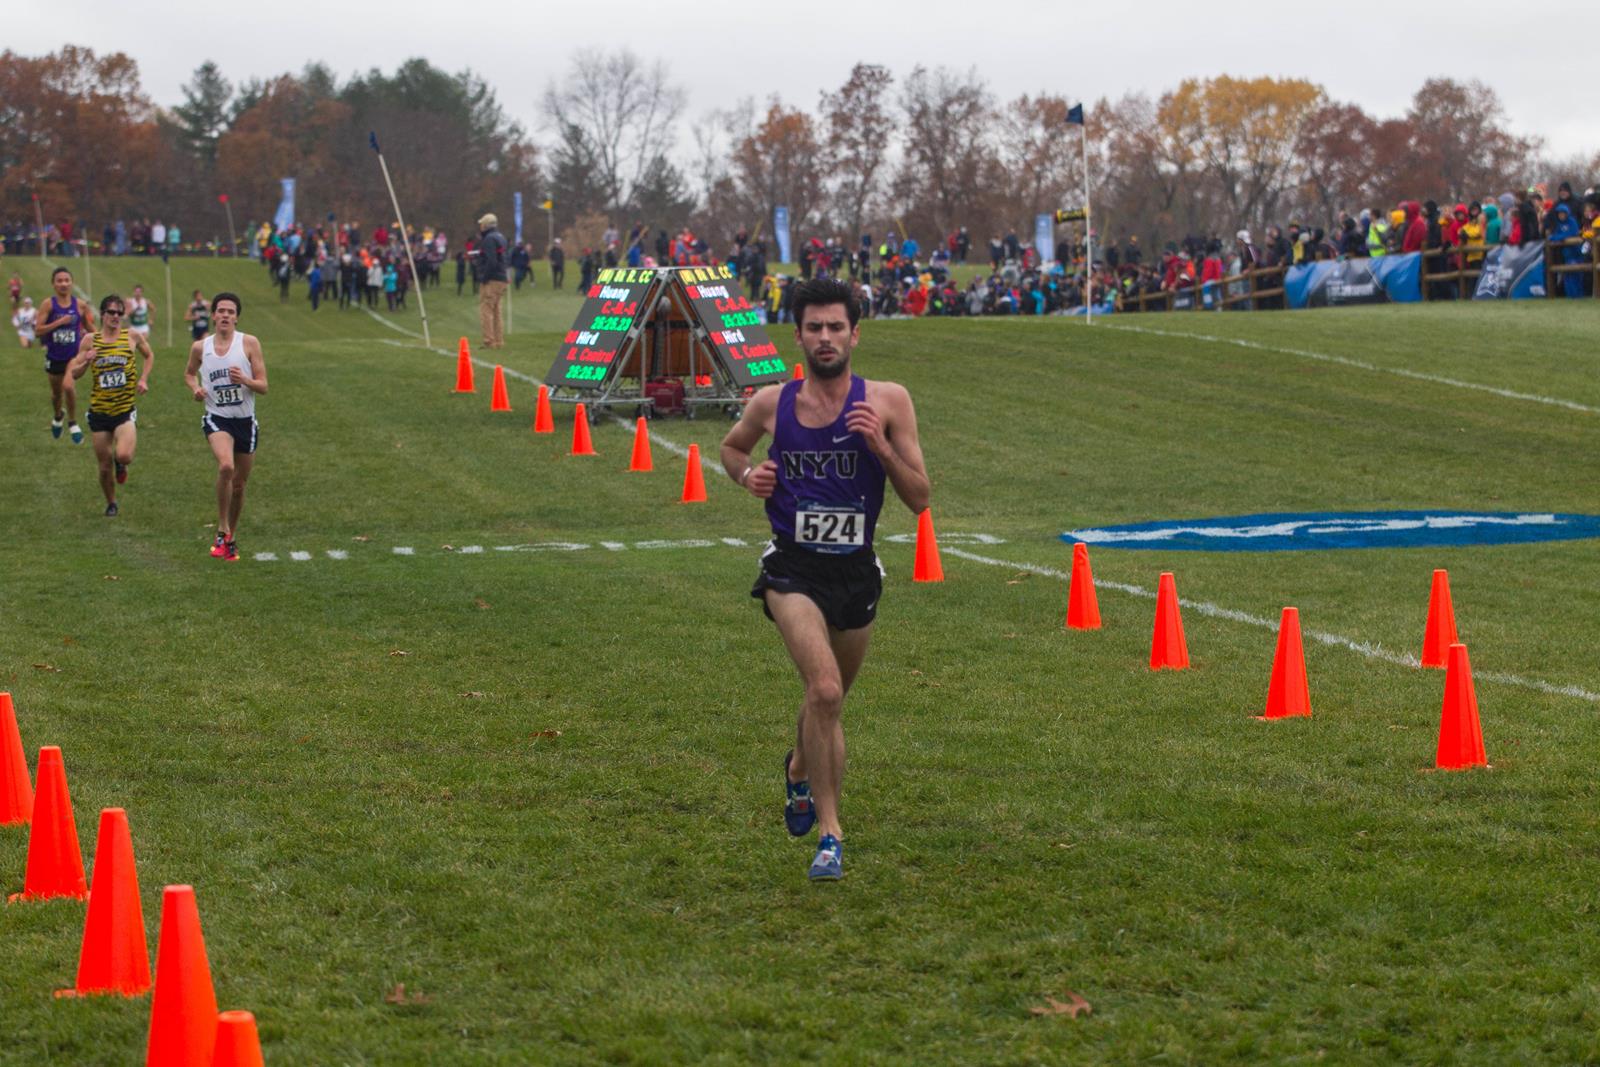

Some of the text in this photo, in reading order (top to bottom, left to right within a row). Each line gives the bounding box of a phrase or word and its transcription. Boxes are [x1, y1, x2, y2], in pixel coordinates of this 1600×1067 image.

[599, 285, 630, 302] Huang
[697, 285, 729, 299] Huang
[576, 331, 600, 345] Hird
[721, 329, 745, 344] Hird
[102, 373, 126, 388] 432
[216, 389, 240, 403] 391
[781, 451, 858, 479] NYU
[803, 514, 857, 543] 524
